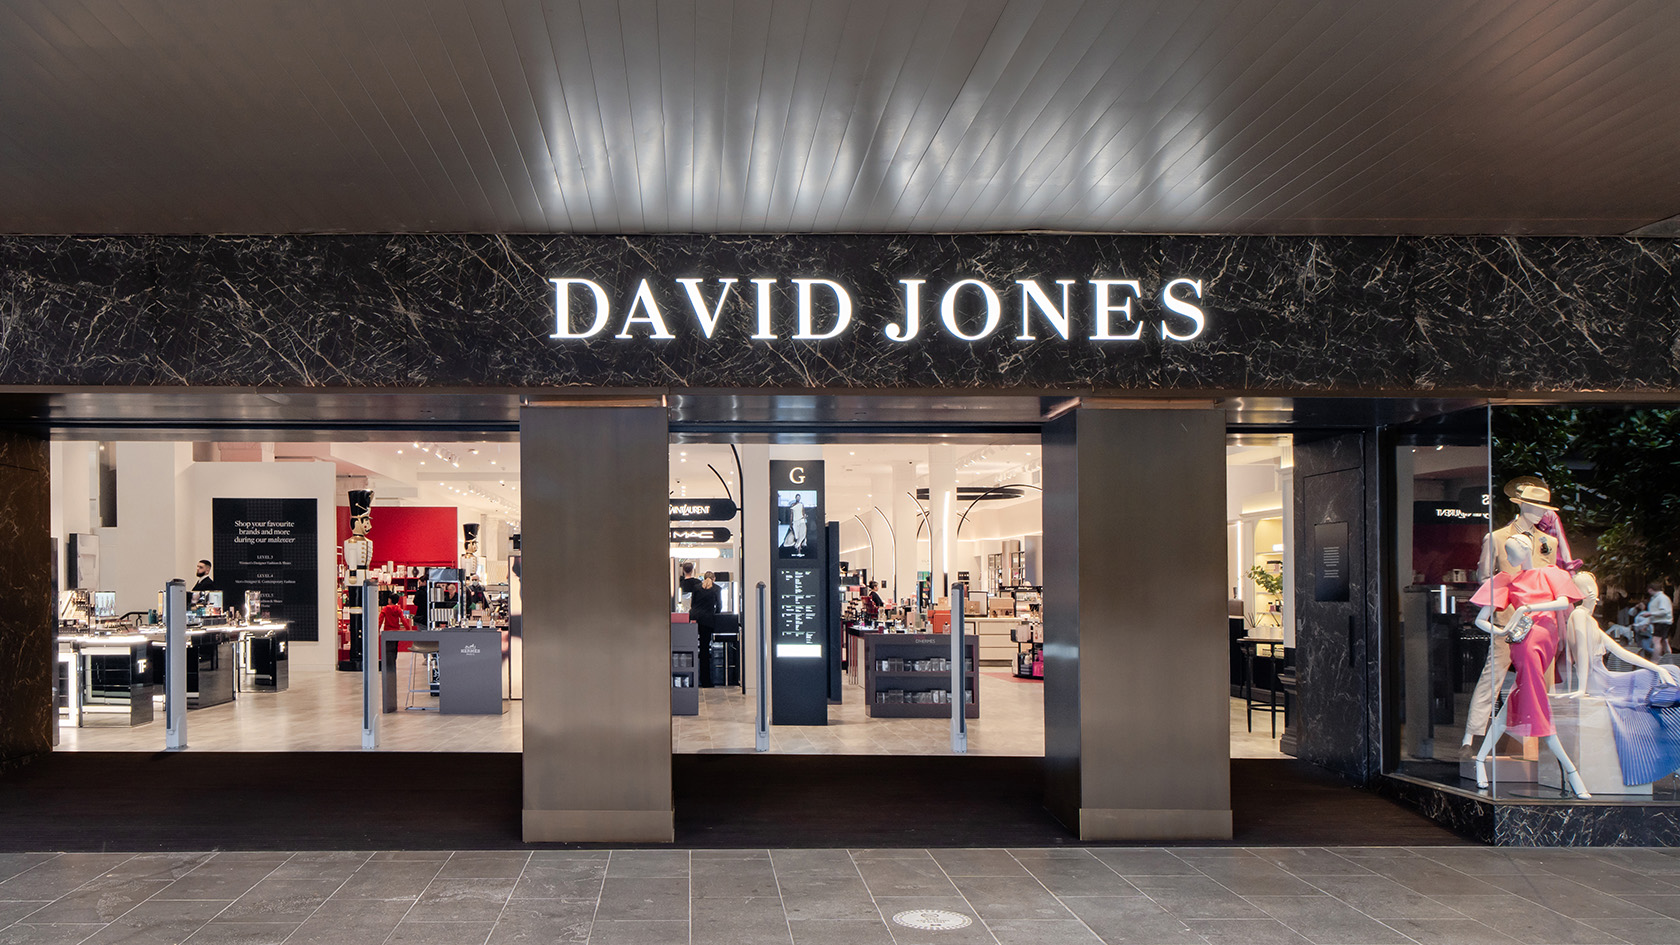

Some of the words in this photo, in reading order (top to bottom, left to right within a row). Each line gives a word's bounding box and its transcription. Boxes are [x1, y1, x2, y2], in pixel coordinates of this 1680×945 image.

[549, 277, 853, 340] DAVID
[886, 277, 1208, 342] JONES
[789, 466, 806, 484] G
[234, 520, 251, 528] Shop
[251, 521, 266, 529] your
[234, 536, 255, 545] during
